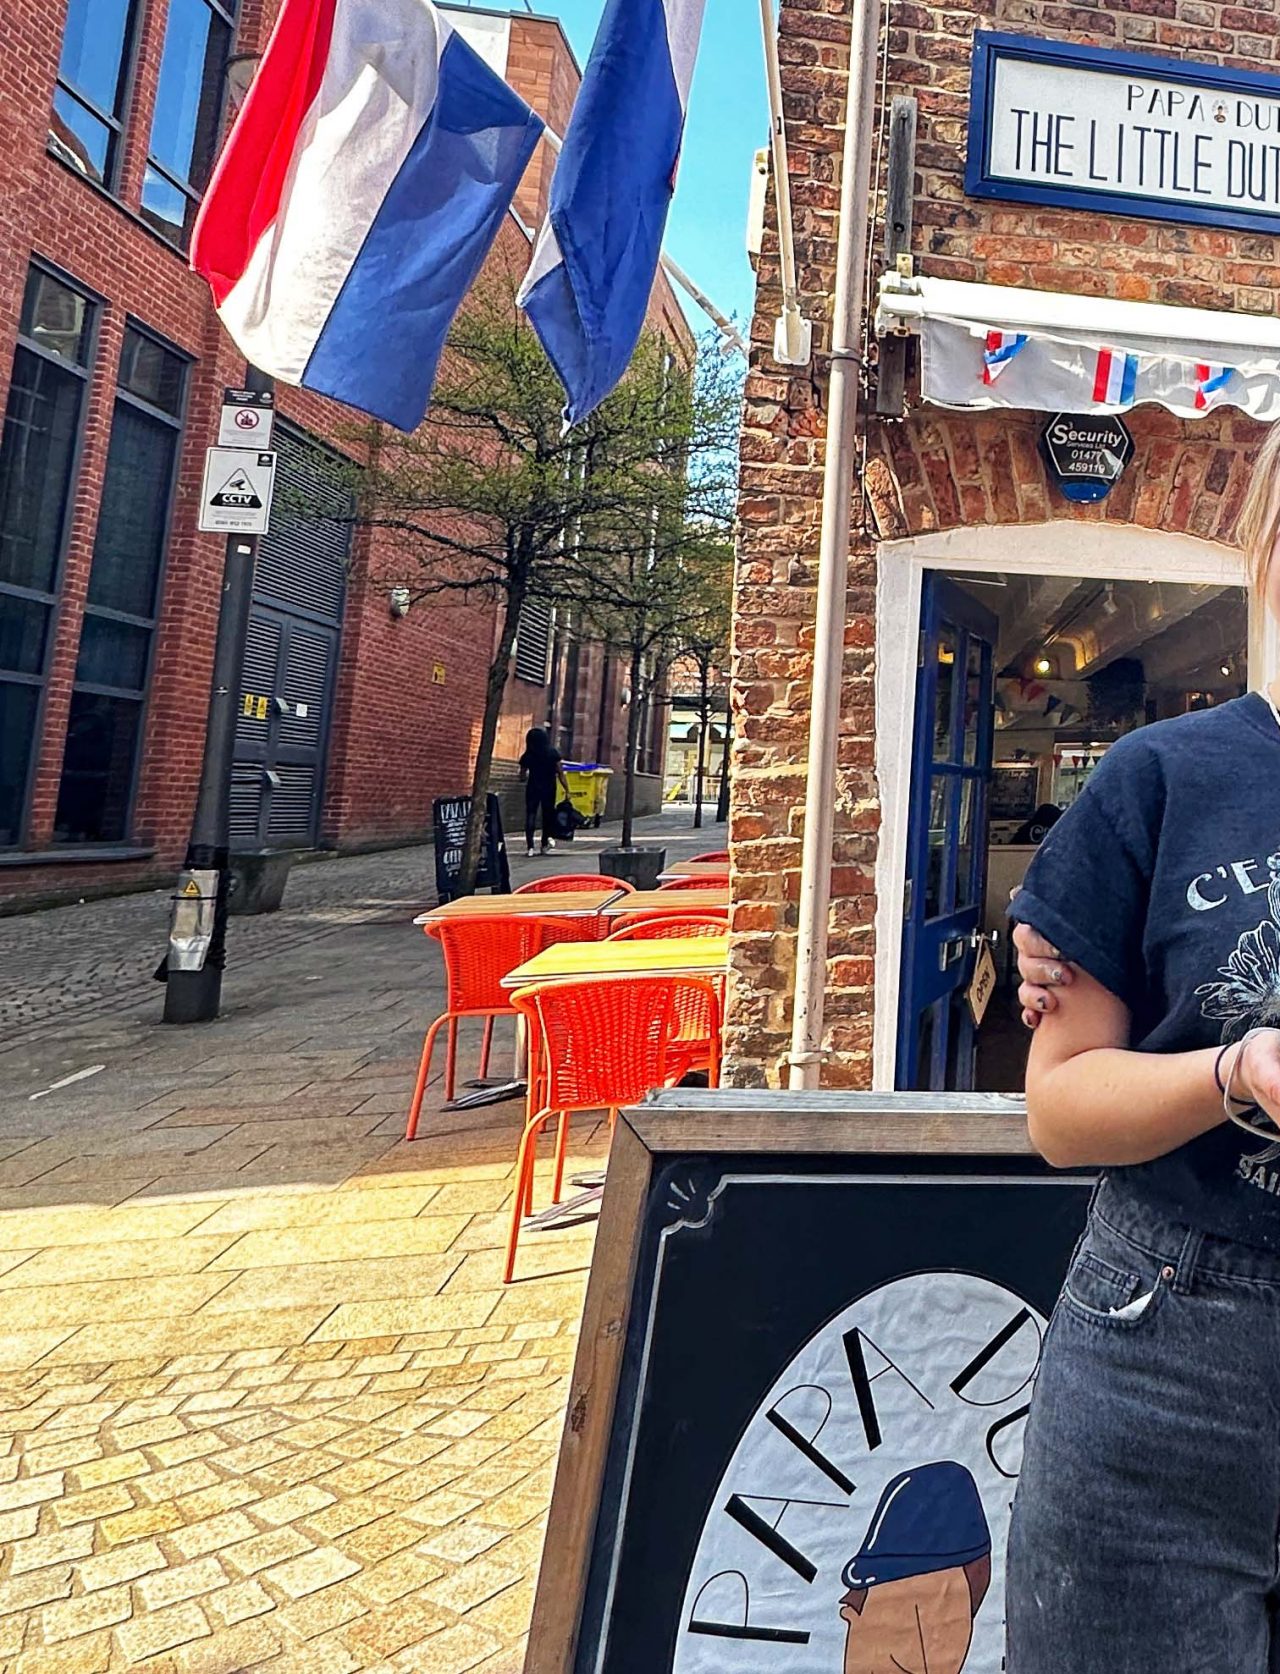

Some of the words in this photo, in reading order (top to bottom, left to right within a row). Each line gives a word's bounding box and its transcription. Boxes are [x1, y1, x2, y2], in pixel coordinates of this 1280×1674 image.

[1127, 84, 1205, 122] PAPA
[1010, 108, 1075, 177] THE
[1089, 120, 1213, 195] LITTLE
[1052, 424, 1122, 447] Security
[221, 494, 252, 504] CCTV
[688, 1327, 935, 1644] PAPA
